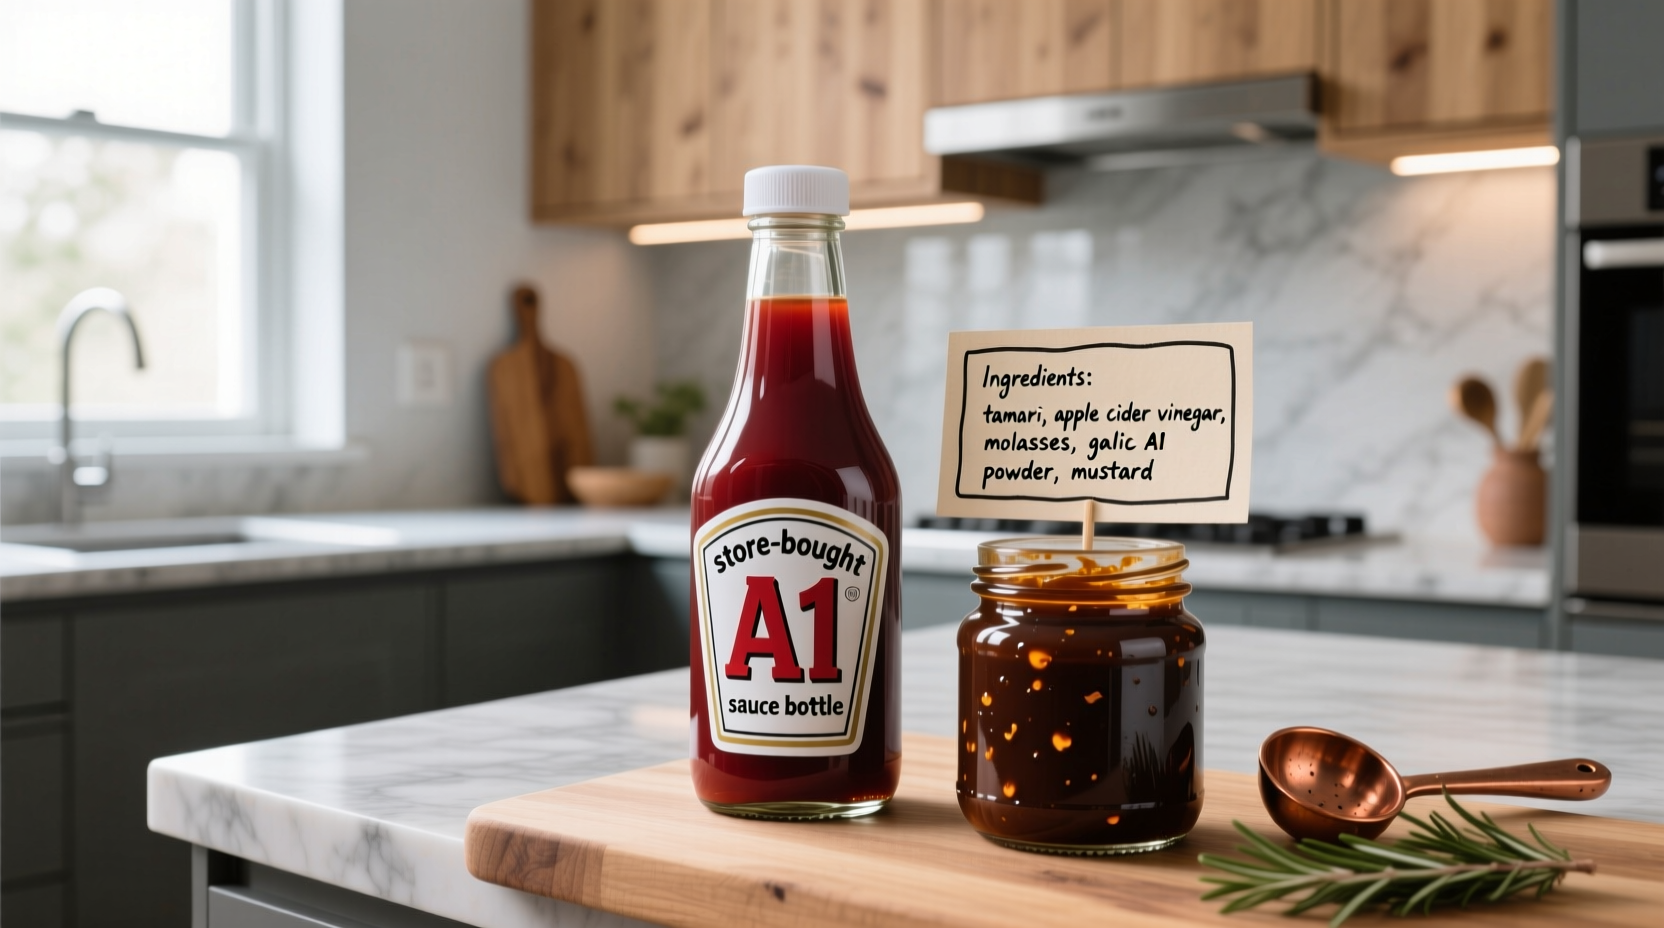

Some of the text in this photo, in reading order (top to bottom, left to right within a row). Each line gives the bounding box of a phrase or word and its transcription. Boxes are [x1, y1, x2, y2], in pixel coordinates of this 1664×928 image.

[982, 364, 1092, 399] Ingredients:
[983, 401, 1226, 432] tamari, apple cider vinegar,
[984, 431, 1077, 455] molasses,
[1086, 431, 1137, 461] galic
[981, 459, 1155, 490] powder, mustard
[713, 528, 867, 577] store-bought
[724, 575, 843, 684] A1
[728, 693, 844, 717] sauce bottle
